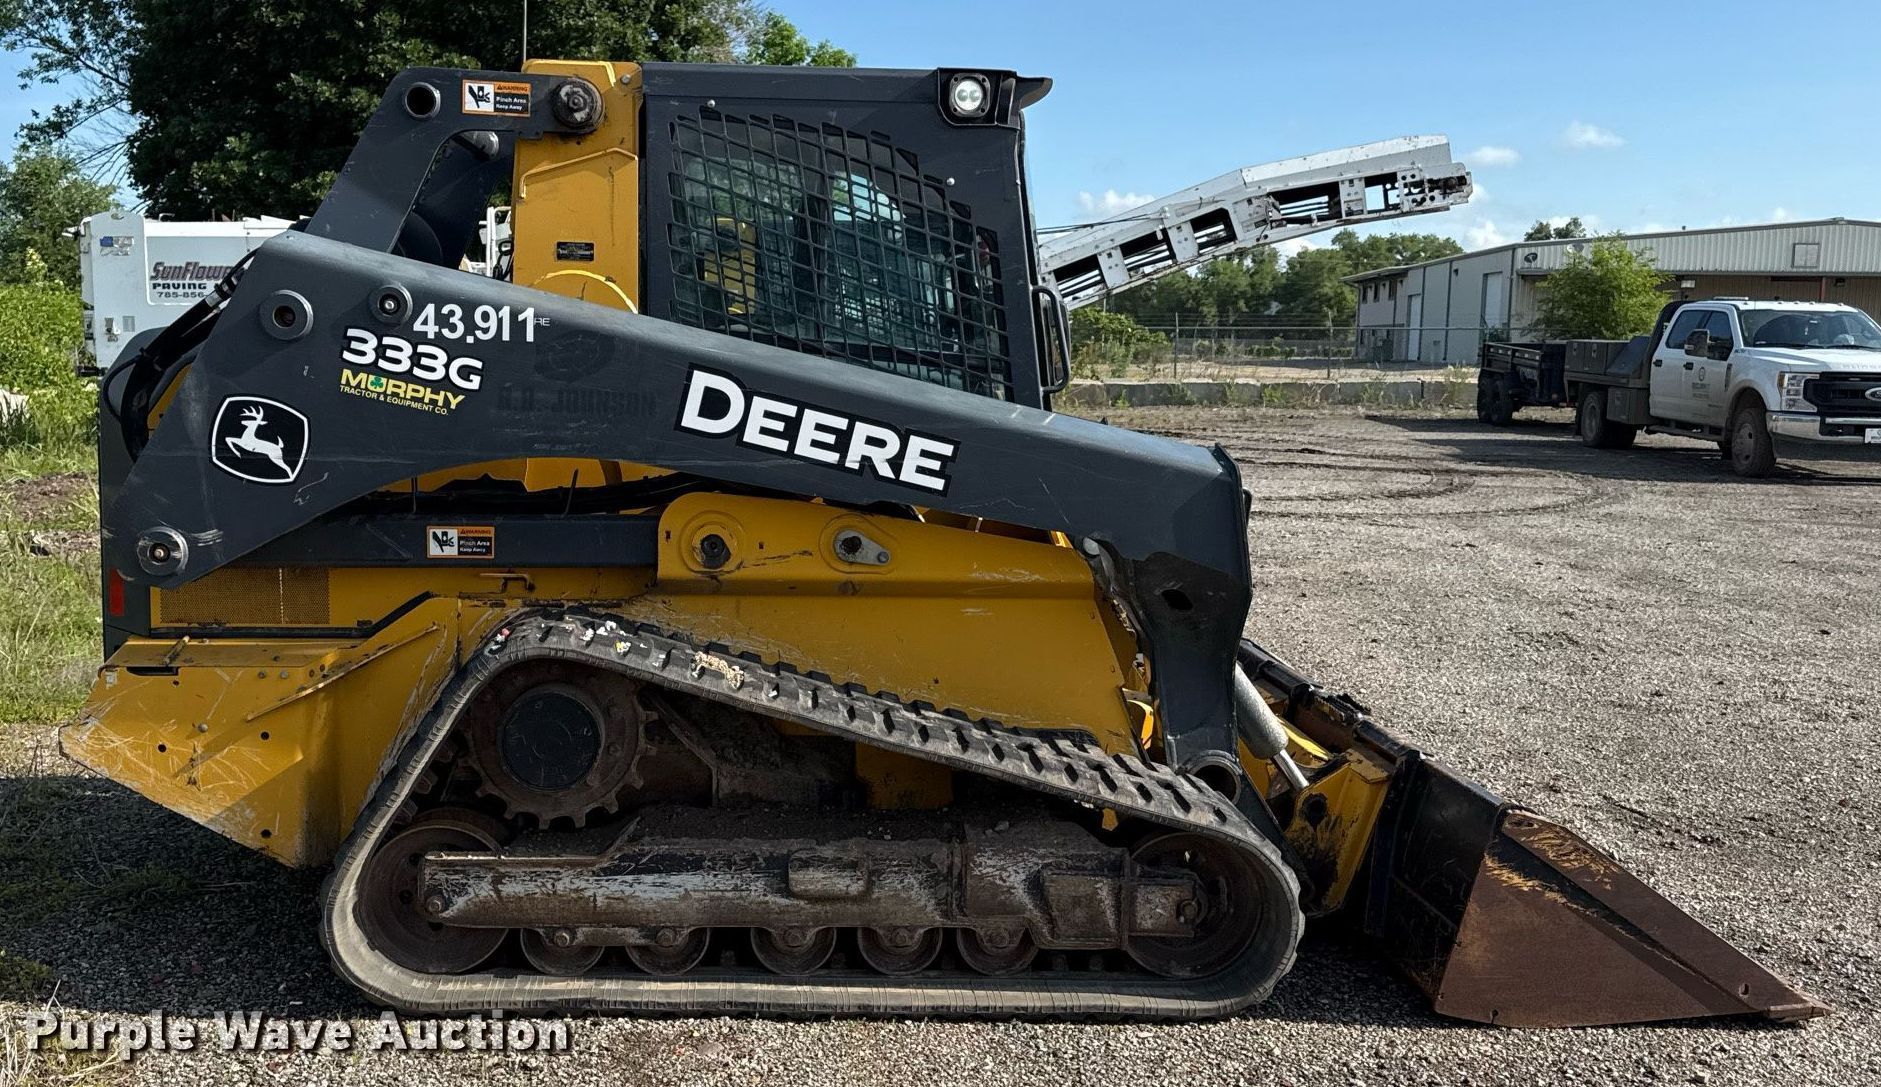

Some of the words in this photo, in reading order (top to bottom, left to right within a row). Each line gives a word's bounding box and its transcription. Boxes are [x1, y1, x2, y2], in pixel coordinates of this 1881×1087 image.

[413, 303, 535, 343] 43.911
[341, 328, 483, 390] 333G
[340, 368, 465, 409] MURPHY
[340, 385, 378, 400] TRACTOR
[387, 396, 434, 412] EQUIPMENT
[435, 405, 449, 415] CO.
[681, 369, 954, 491] DEERE
